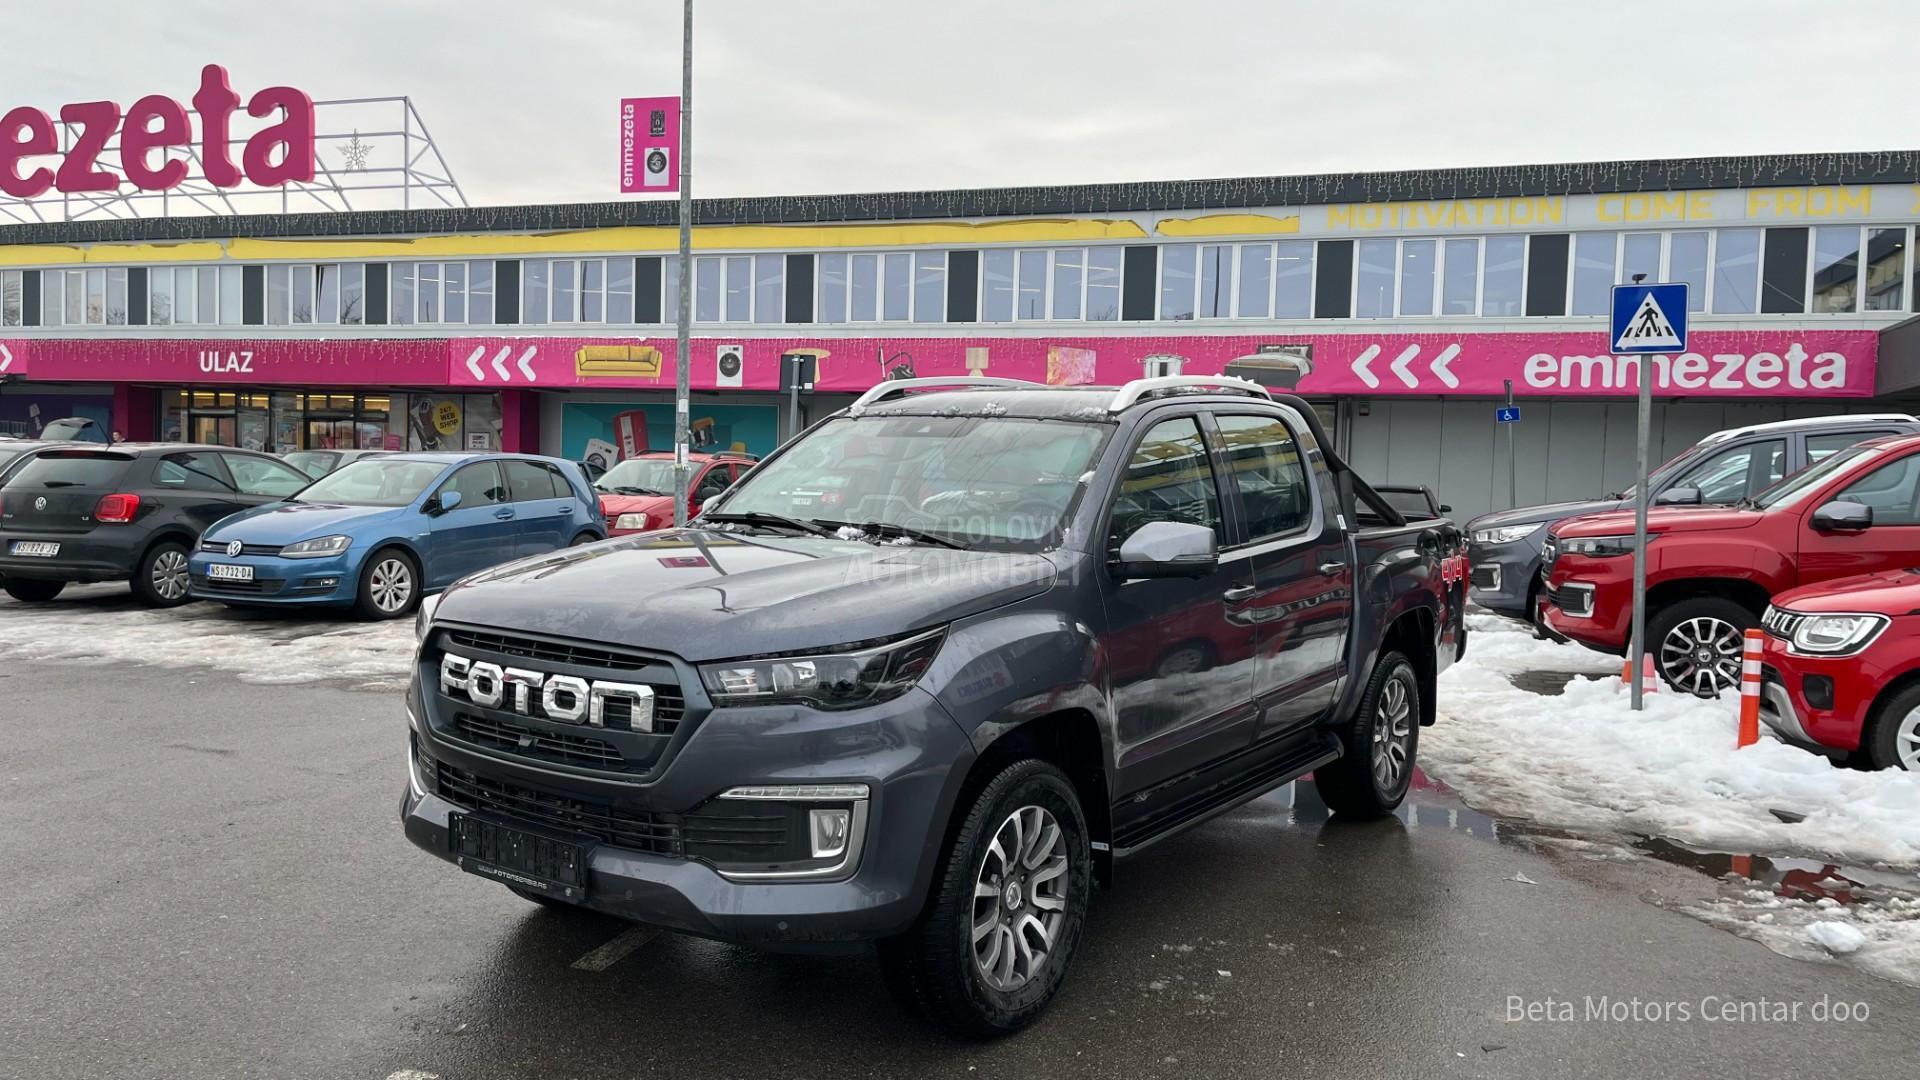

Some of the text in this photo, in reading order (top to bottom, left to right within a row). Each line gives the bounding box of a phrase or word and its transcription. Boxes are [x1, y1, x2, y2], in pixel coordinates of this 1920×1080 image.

[622, 104, 634, 187] emmezeta
[1327, 185, 1872, 229] MOTIVATION COME FROM
[200, 351, 254, 372] ULAZ
[1523, 342, 1847, 389] emmezeta
[439, 419, 458, 429] SHOP
[440, 412, 456, 421] WEB
[441, 652, 655, 733] FOTON
